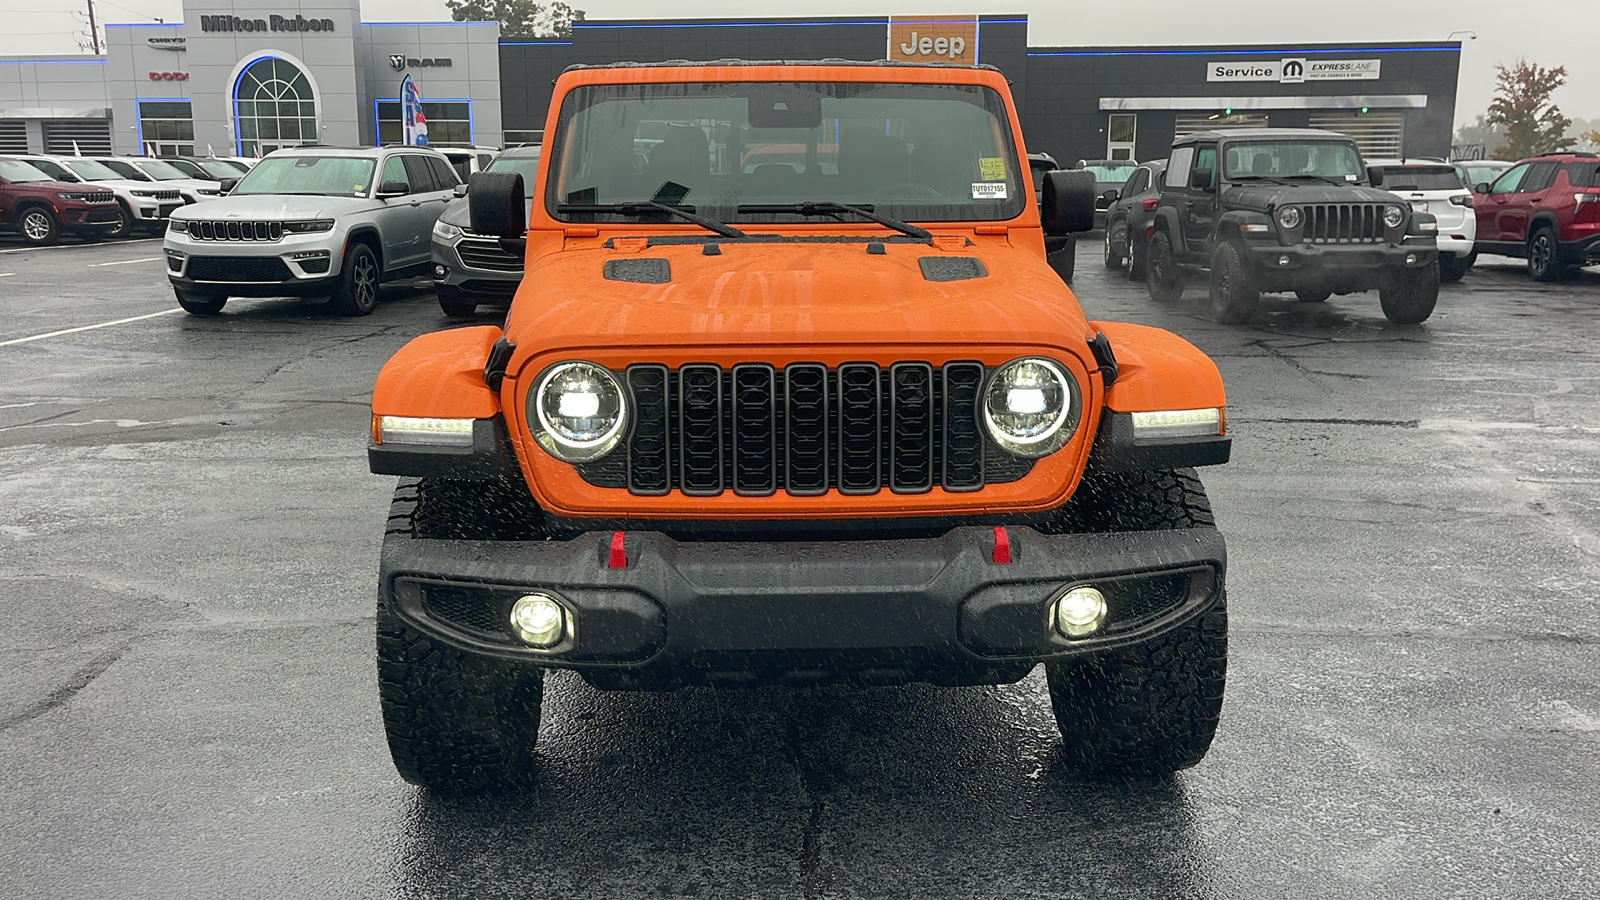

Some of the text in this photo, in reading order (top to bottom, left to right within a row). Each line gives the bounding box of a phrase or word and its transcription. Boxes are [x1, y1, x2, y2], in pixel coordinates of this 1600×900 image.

[200, 14, 334, 32] Milton Ruben
[900, 31, 966, 59] Jeep
[406, 58, 452, 67] RAM
[1215, 66, 1273, 77] Service
